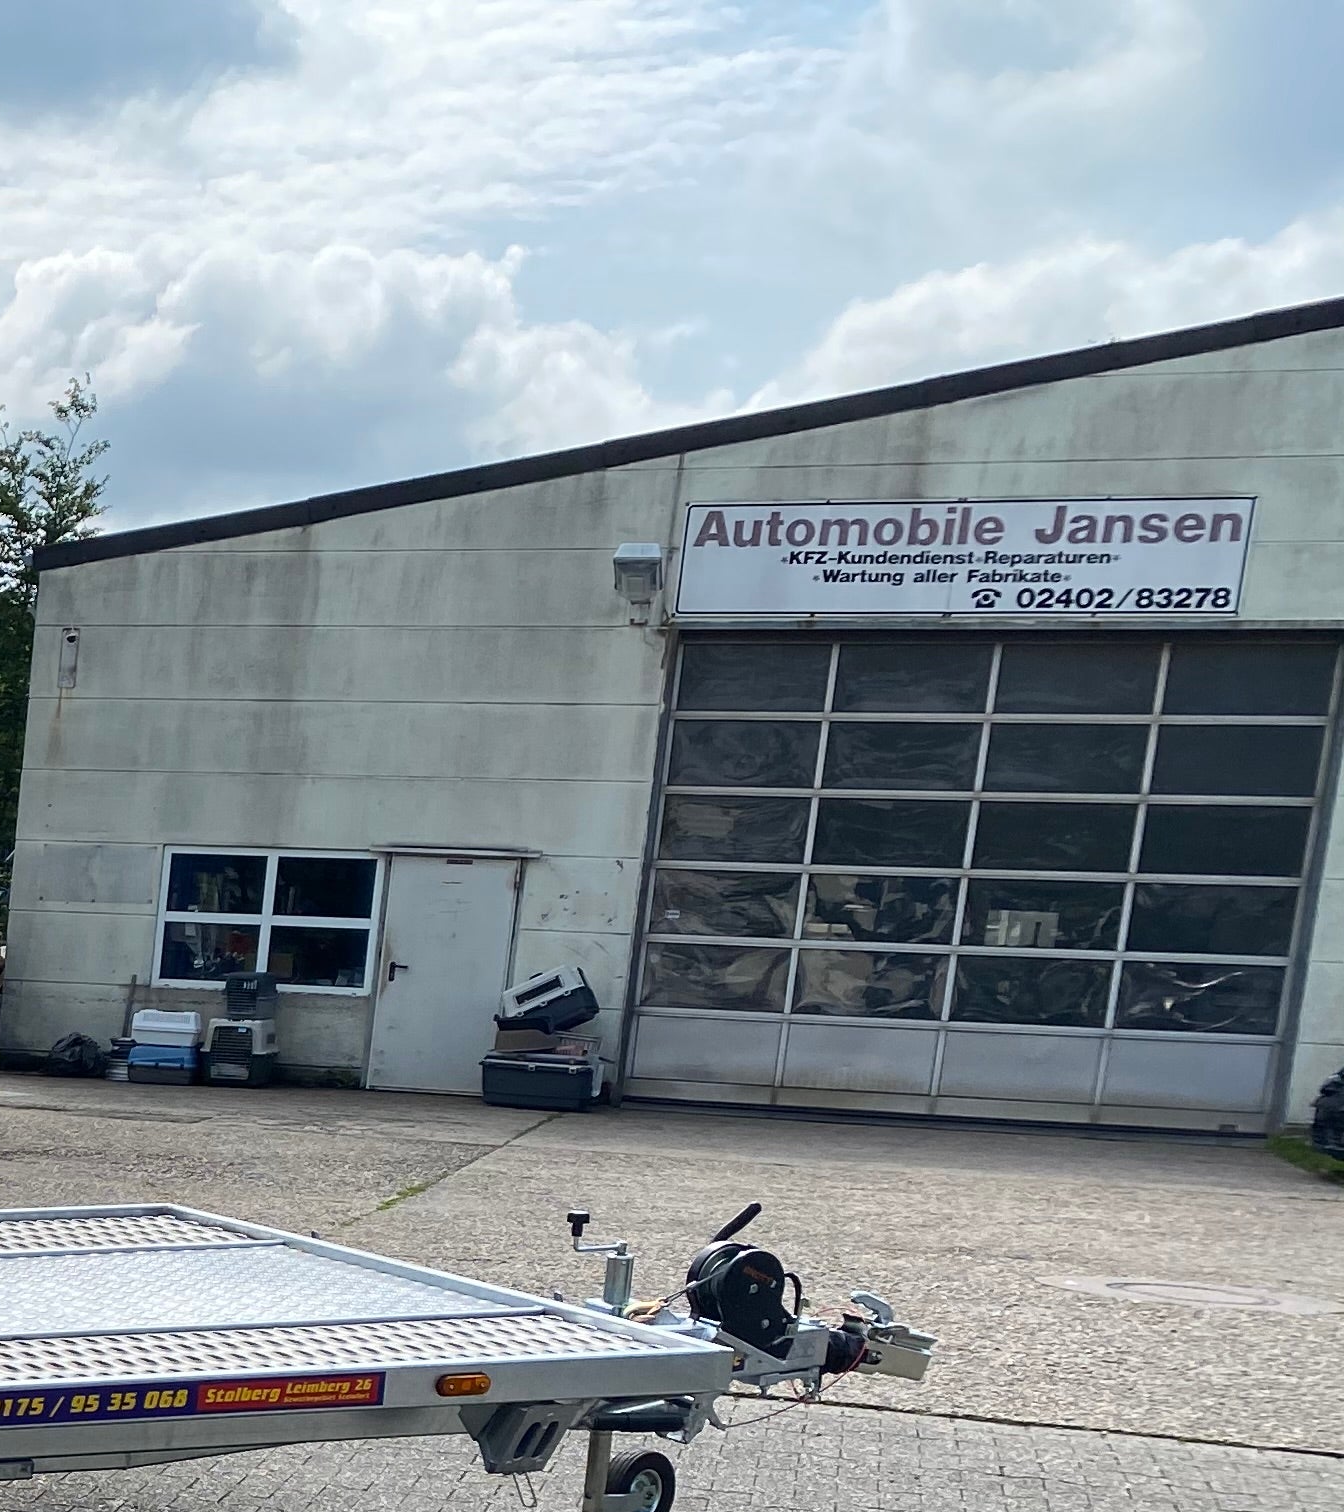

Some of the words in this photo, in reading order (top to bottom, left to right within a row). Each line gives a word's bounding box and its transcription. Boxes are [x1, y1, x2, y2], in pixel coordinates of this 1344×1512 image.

[693, 507, 1005, 548] Automobile
[1035, 505, 1243, 546] Jansen
[913, 569, 958, 583] aller
[1016, 588, 1231, 609] 02402/83278
[70, 1395, 100, 1414] 95
[107, 1392, 137, 1411] 35
[144, 1390, 188, 1409] 068
[205, 1387, 281, 1403] Stolberg
[286, 1381, 351, 1394] Leimberg
[355, 1379, 372, 1391] 26
